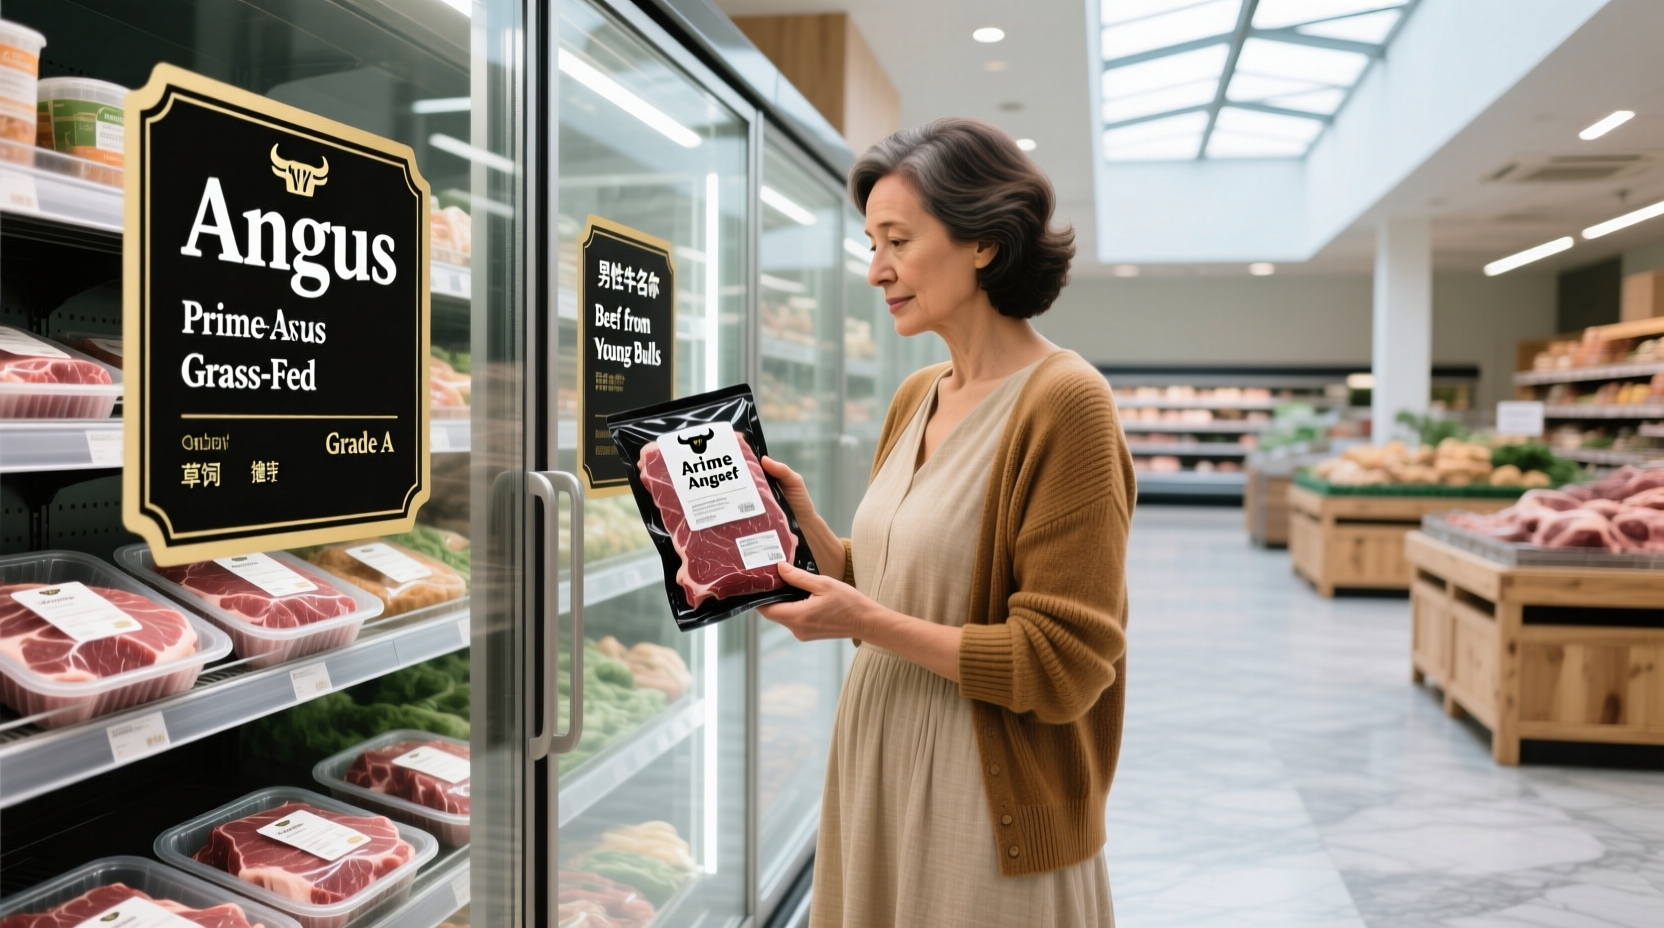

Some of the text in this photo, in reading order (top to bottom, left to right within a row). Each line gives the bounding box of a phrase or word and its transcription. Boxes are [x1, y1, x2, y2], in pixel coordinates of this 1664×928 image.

[181, 176, 397, 298] Angus
[595, 303, 651, 334] Beef from
[593, 337, 662, 368] Young Bulls
[181, 353, 317, 391] Grass-Fed
[325, 430, 395, 455] Grade A
[682, 455, 733, 476] Arime
